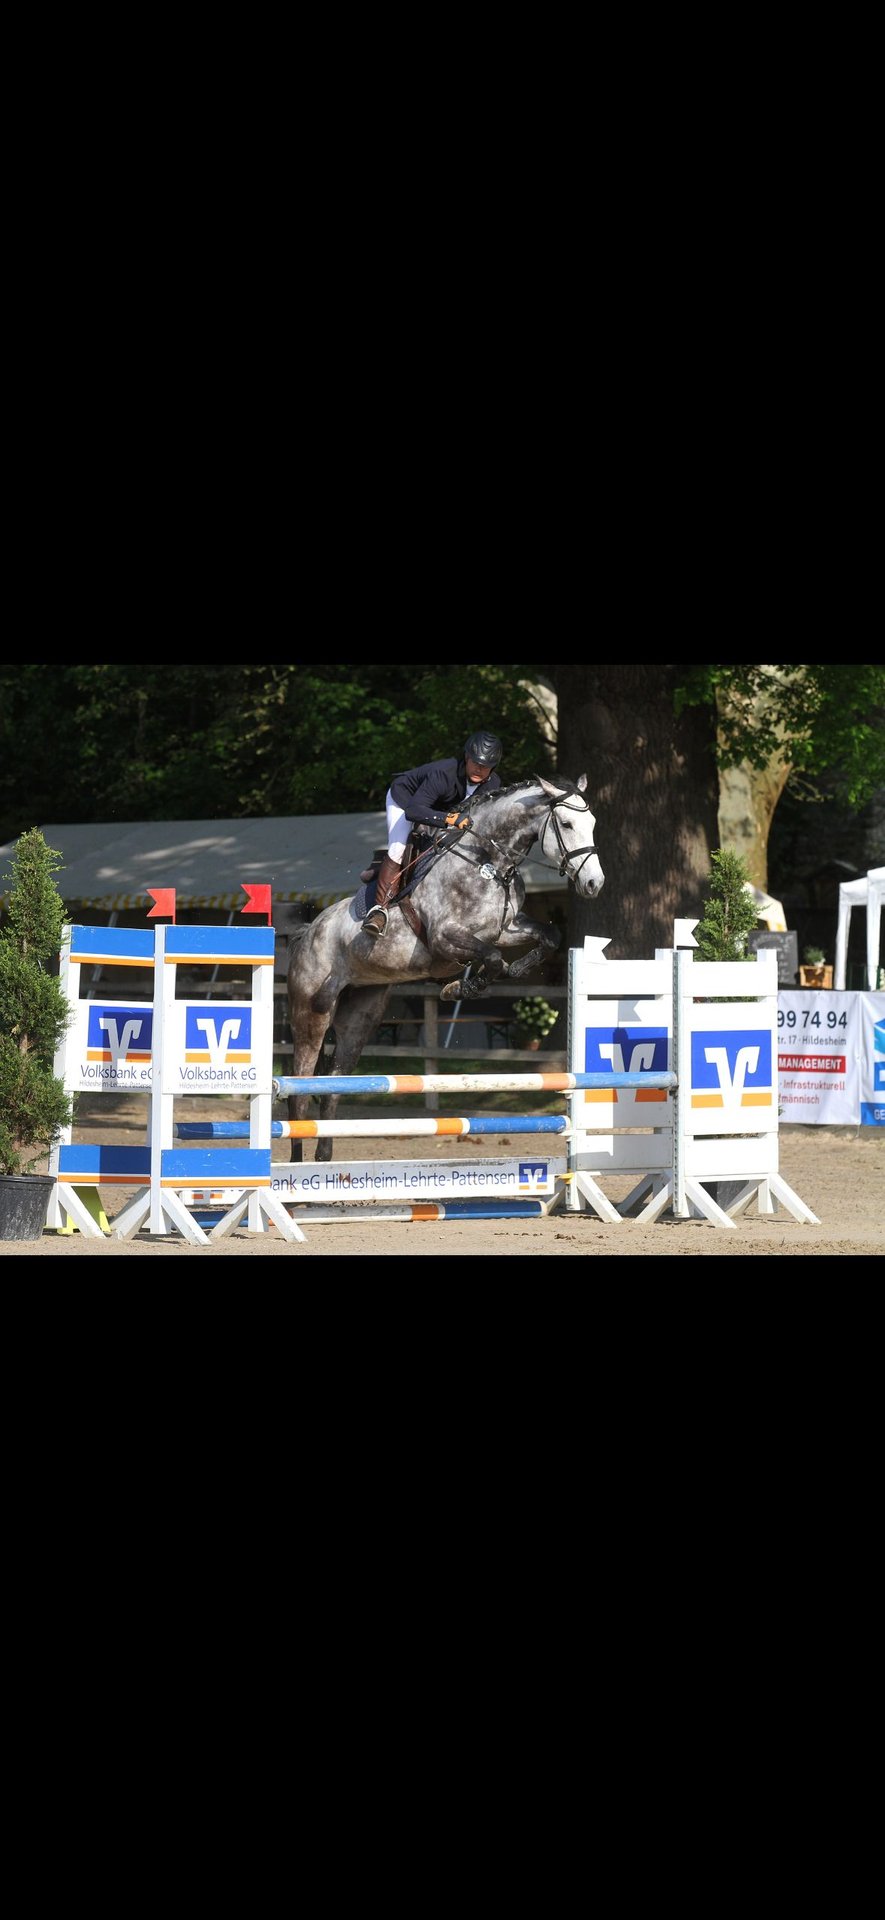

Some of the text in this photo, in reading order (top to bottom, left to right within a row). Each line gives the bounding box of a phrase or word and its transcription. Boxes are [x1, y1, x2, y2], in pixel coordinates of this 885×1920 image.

[802, 1010, 822, 1028] 74
[827, 1010, 848, 1029] 94
[788, 1035, 797, 1045] 17
[802, 1035, 847, 1046] Hildesheim
[778, 1057, 842, 1070] MANAGEMENT
[80, 1064, 137, 1079] Volksbank
[179, 1066, 257, 1081] Volksbank eG
[783, 1079, 845, 1091] Infrastrukturell
[270, 1171, 516, 1192] ank eG Hildesheim-Lehrte-Pattensen
